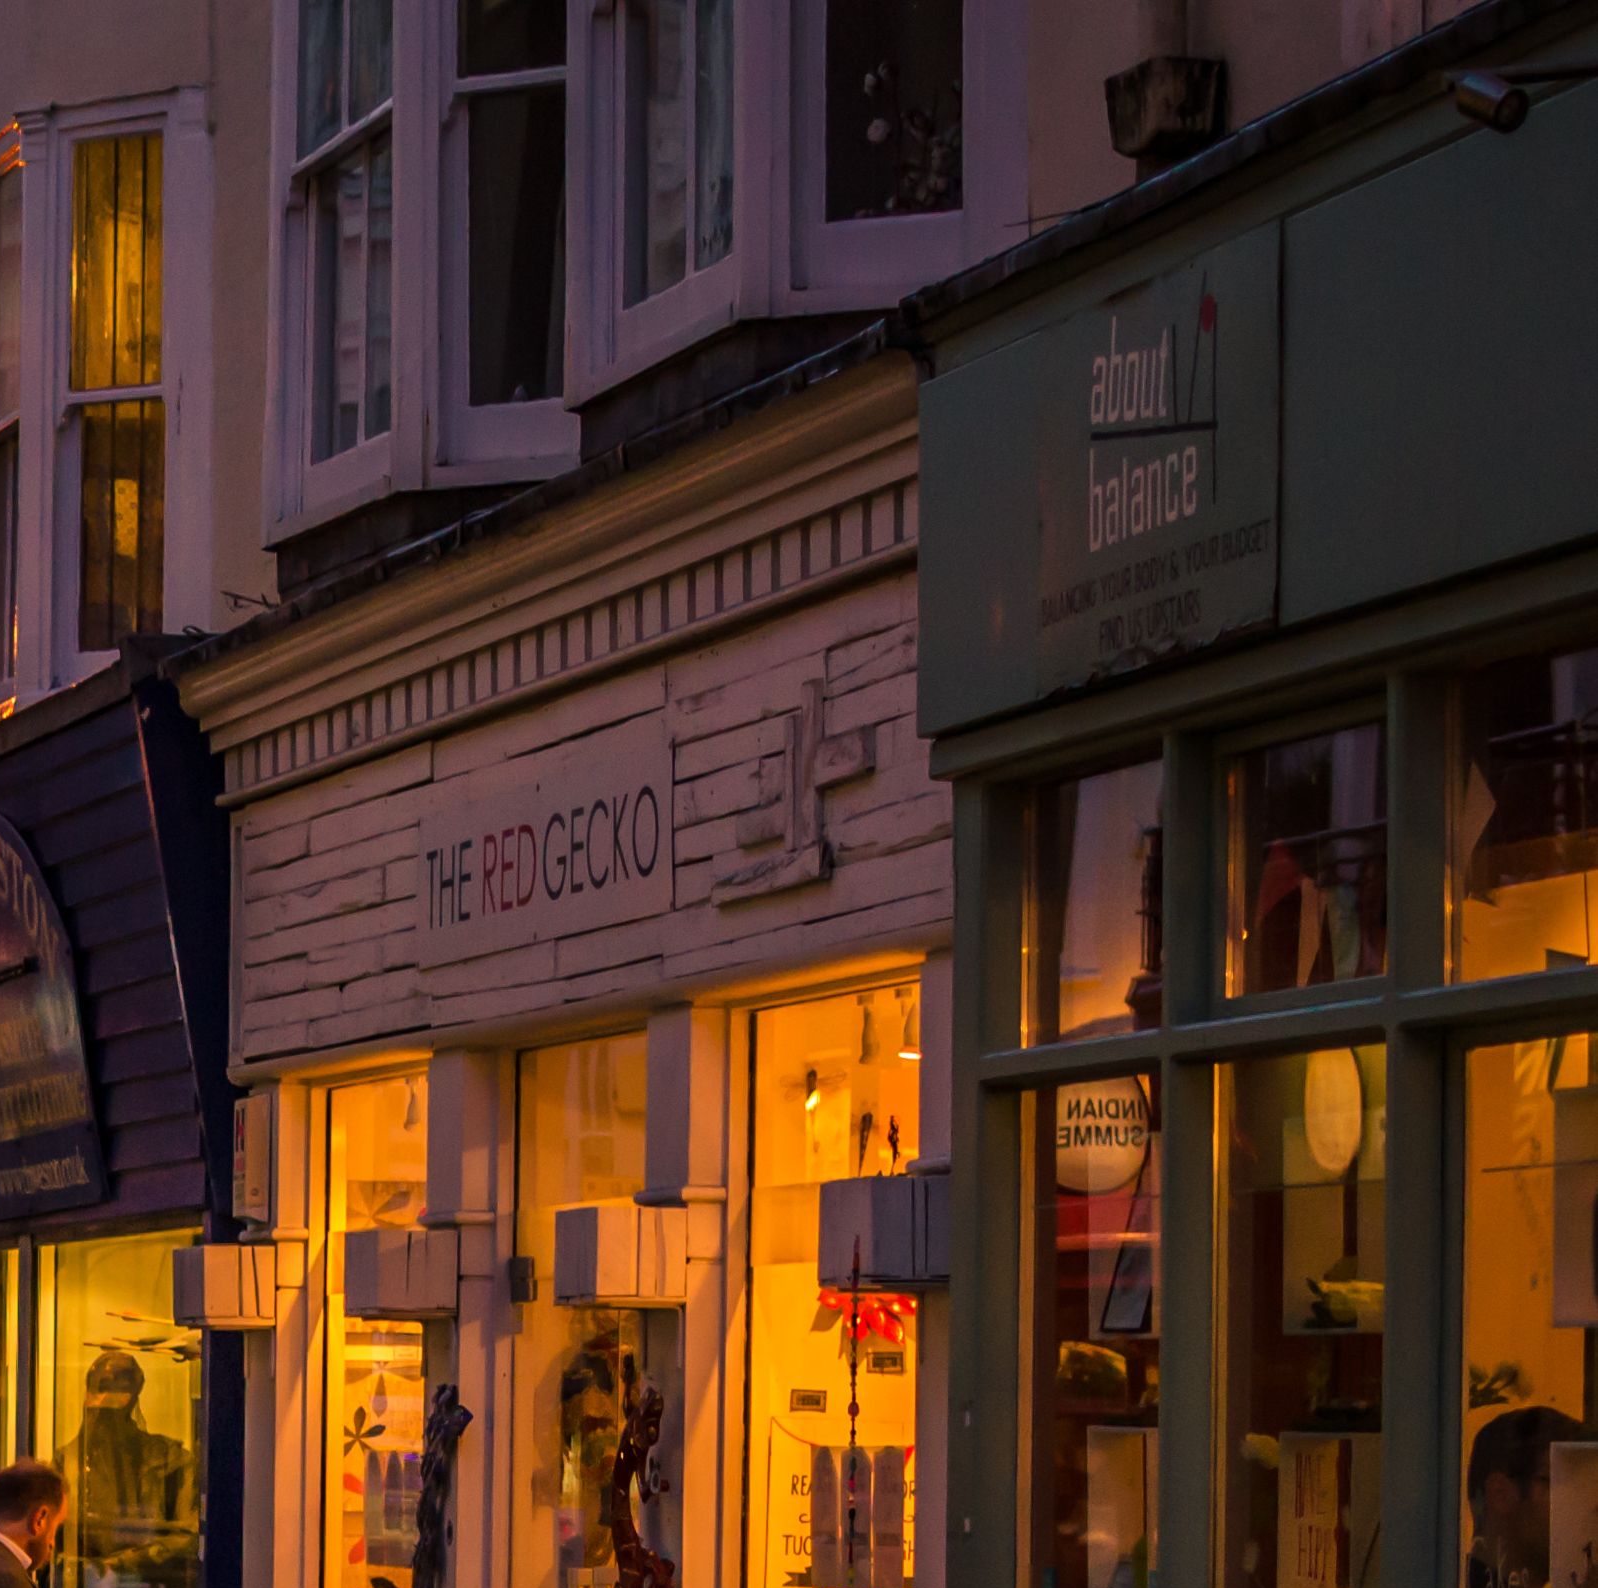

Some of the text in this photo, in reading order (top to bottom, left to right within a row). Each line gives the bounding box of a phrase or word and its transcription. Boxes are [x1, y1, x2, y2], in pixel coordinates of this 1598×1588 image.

[1089, 315, 1169, 425] about
[1088, 444, 1198, 553] balance
[1099, 565, 1132, 602] YOUR
[1134, 555, 1166, 593] BODY
[1184, 535, 1220, 573] YOUR
[1222, 518, 1272, 563] BUDGET
[426, 785, 659, 930] THE RED GECKO
